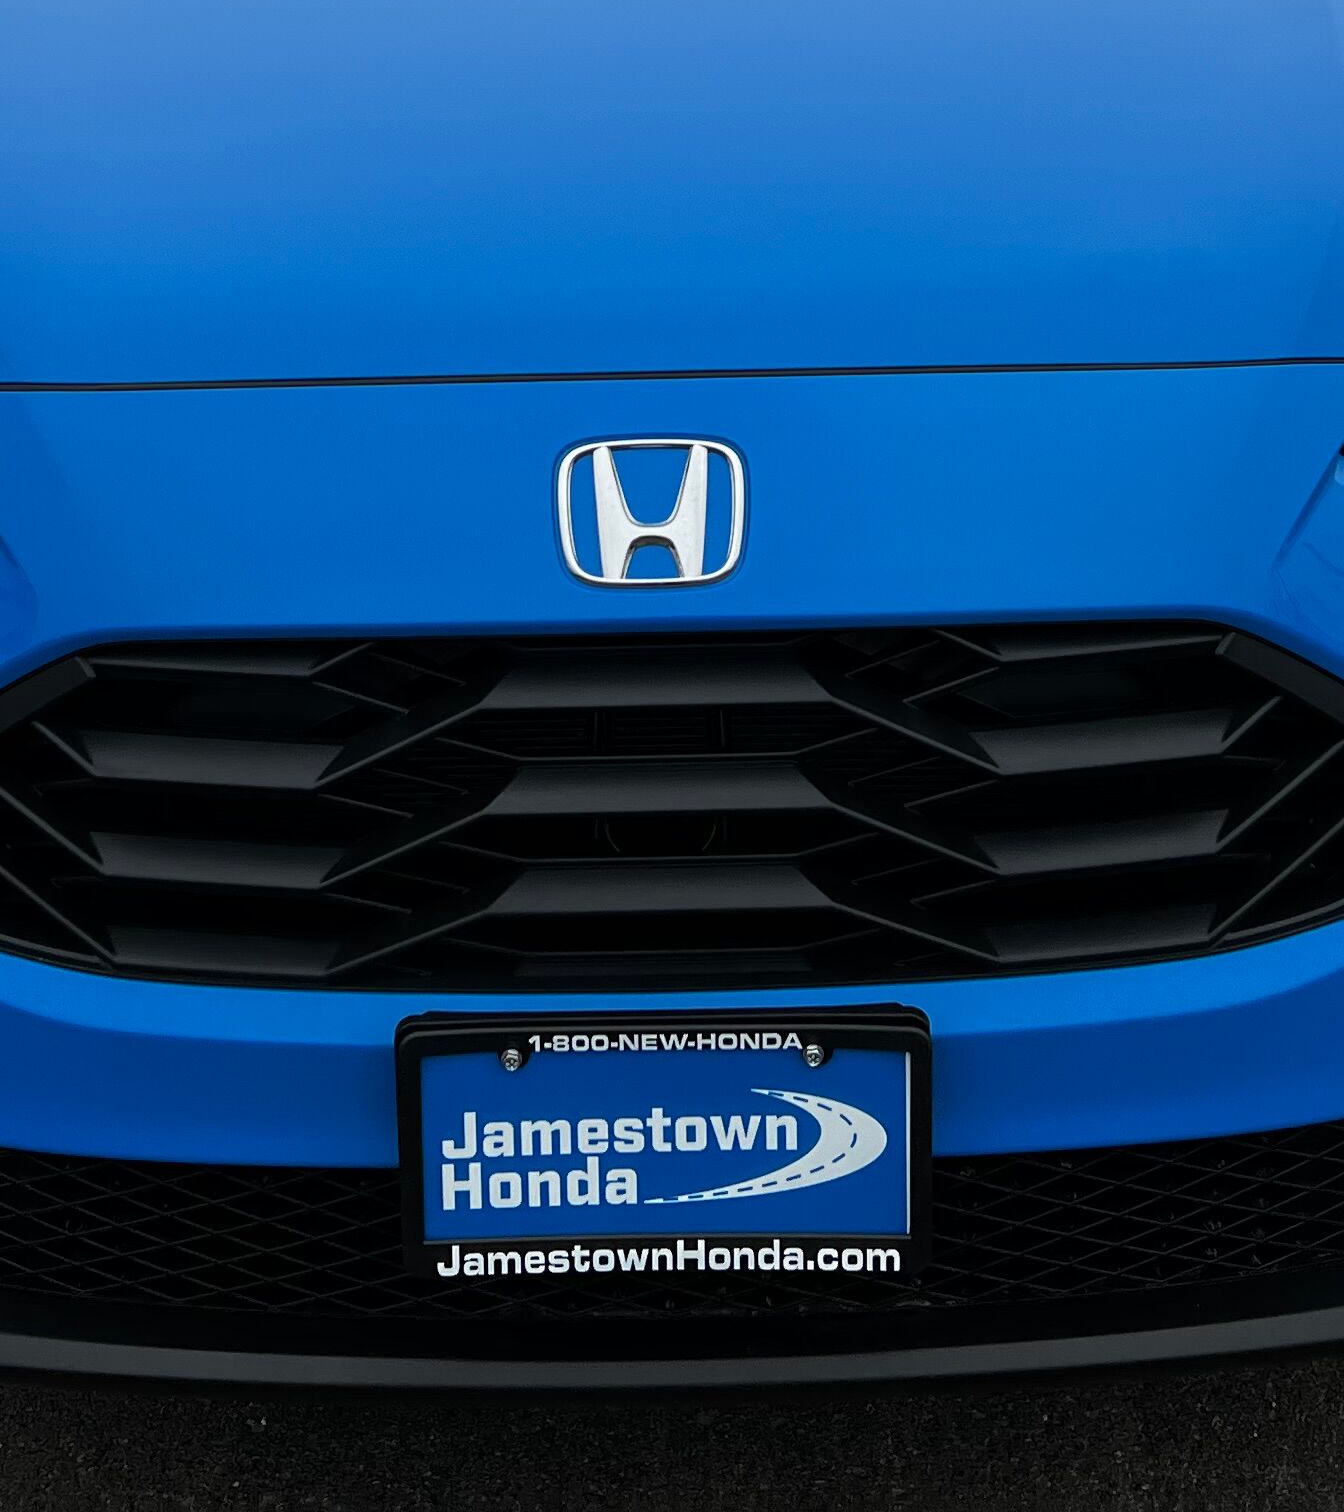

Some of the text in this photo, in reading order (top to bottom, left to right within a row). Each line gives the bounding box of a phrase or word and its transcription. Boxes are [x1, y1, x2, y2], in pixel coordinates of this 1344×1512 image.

[528, 1032, 803, 1051] 1-800-NEW-HONDA
[441, 1107, 799, 1160] Jamestown
[441, 1156, 639, 1210] Honda
[436, 1238, 902, 1277] JamestownHonda.com
